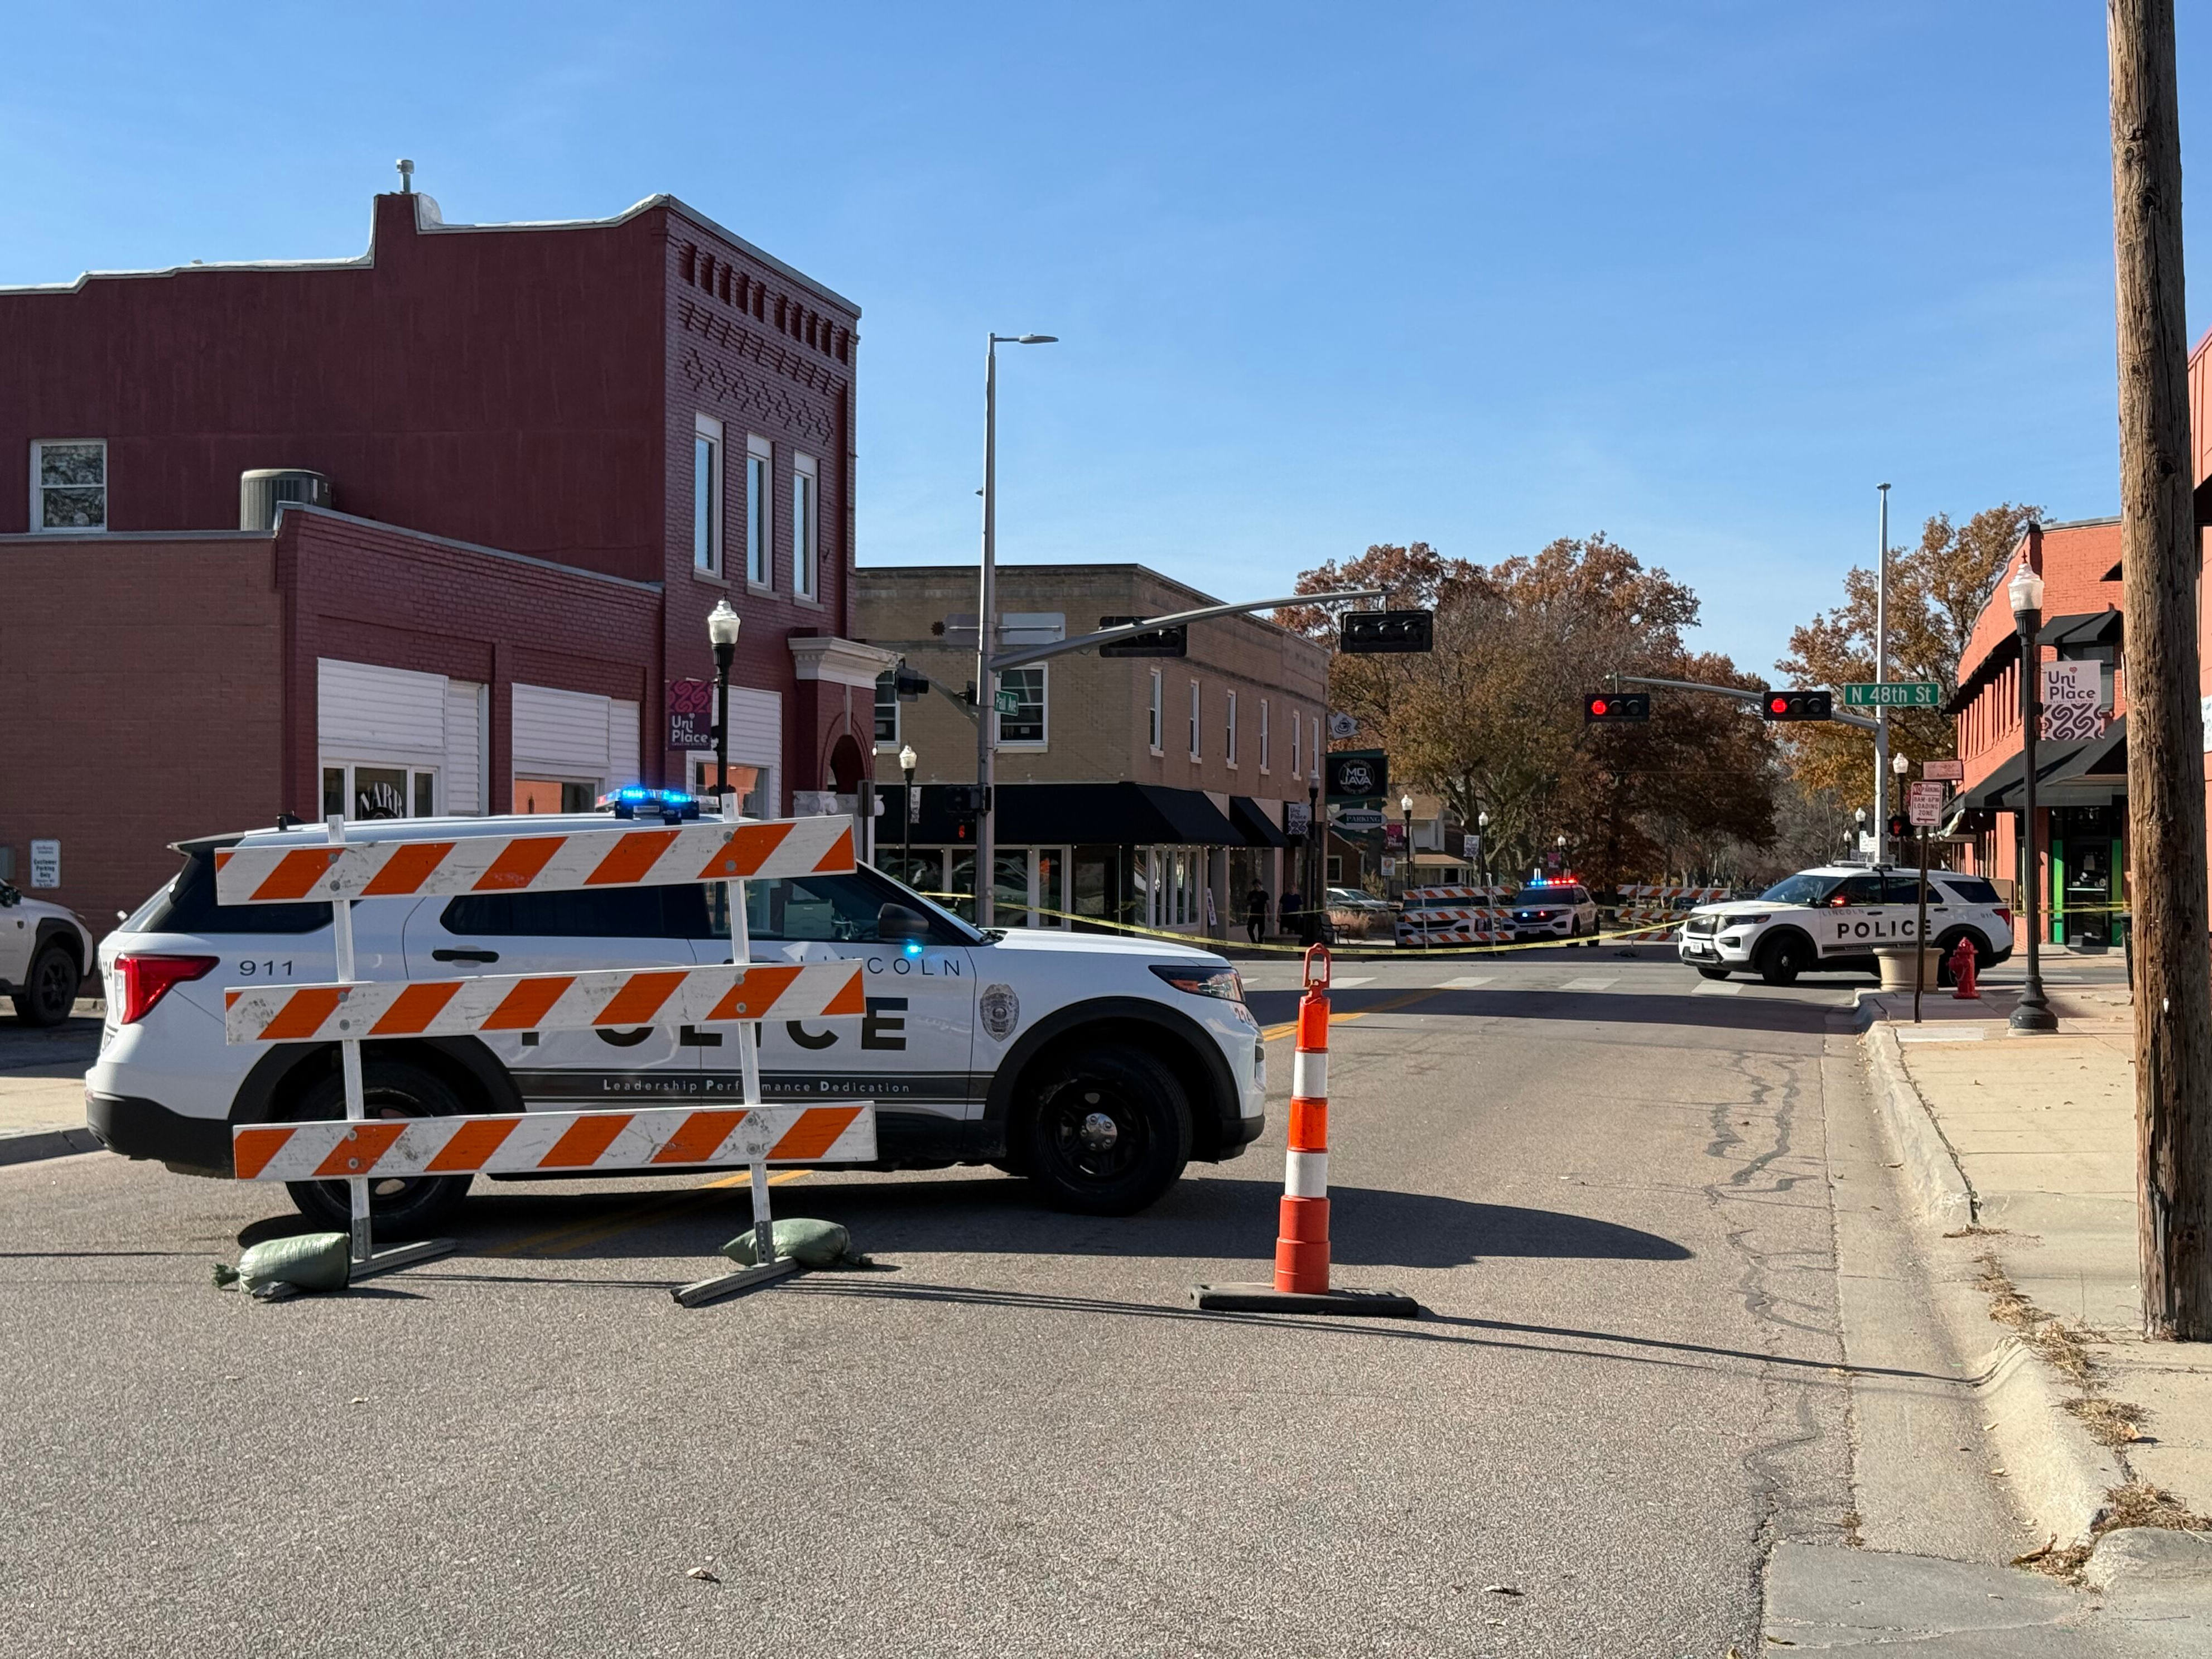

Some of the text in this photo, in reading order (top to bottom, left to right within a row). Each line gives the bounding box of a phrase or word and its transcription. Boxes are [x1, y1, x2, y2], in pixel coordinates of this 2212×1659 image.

[2048, 667, 2078, 689] Uni
[1852, 686, 1931, 703] N 48th St
[2049, 686, 2096, 700] Place
[672, 713, 695, 733] Uni
[672, 729, 709, 743] Place
[1346, 768, 1367, 777] MO
[1340, 776, 1372, 785] JAVA
[1914, 785, 1921, 793] NO
[1837, 919, 1932, 939] POLICE
[239, 959, 293, 976] 911
[800, 955, 960, 976] COLN
[603, 1079, 910, 1093] Leadership Perfmance Dedication
